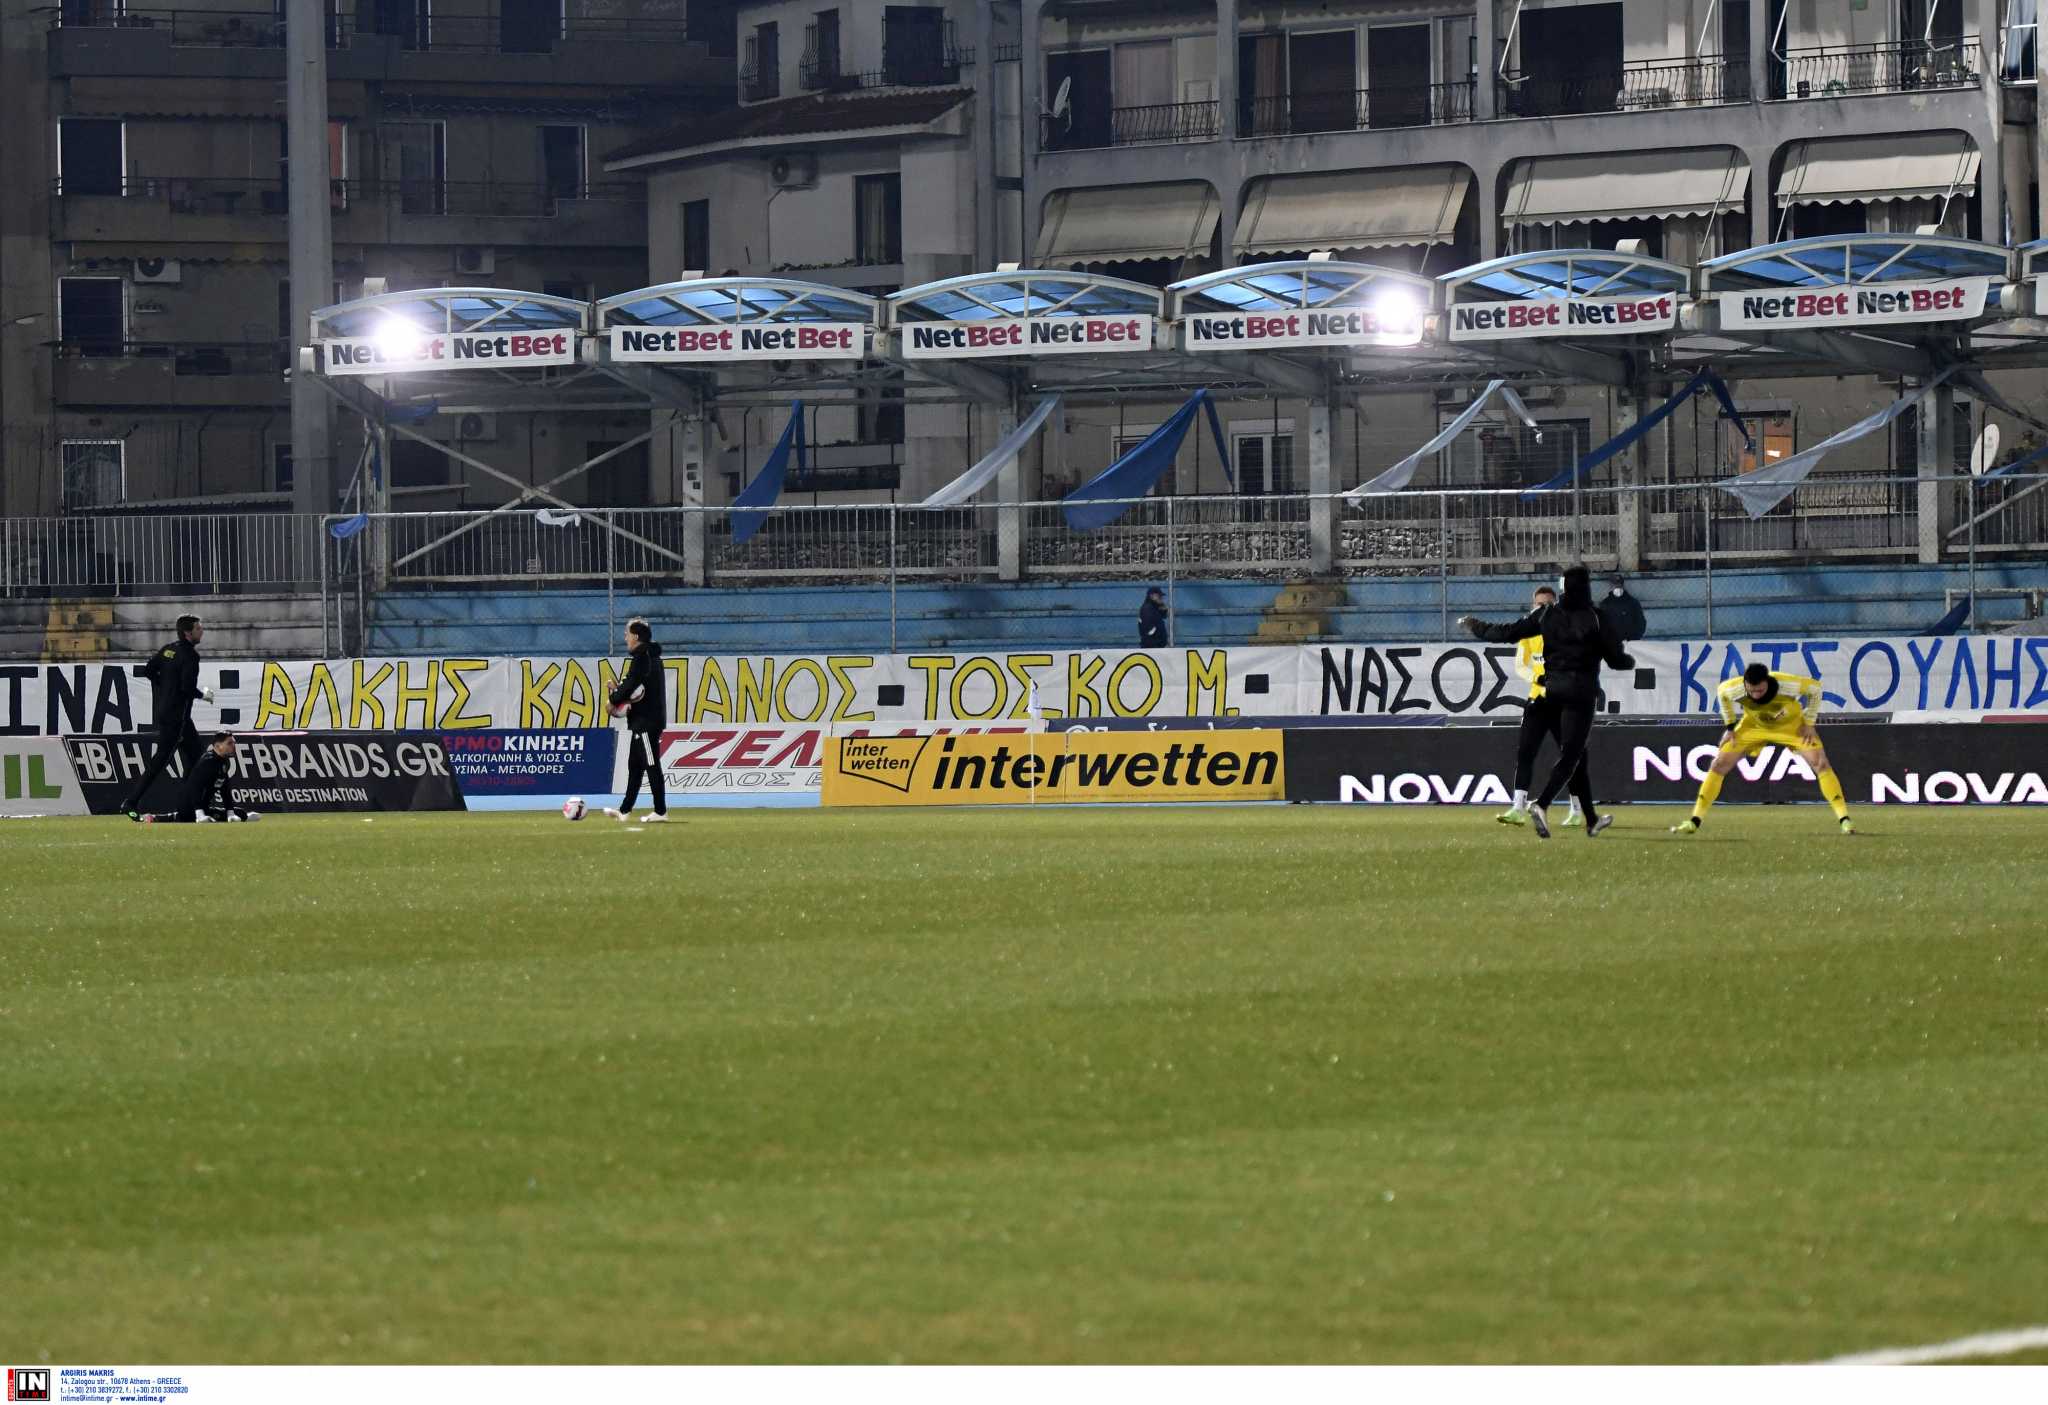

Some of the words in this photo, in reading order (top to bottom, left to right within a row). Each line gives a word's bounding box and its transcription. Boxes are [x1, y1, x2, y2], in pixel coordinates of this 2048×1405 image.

[1455, 303, 1561, 331] NetBet
[1568, 297, 1672, 325] NetBet
[1744, 292, 1849, 320] NetBet
[1857, 286, 1966, 314] NetBet
[622, 329, 734, 352] NetBet
[741, 327, 853, 350] NetBet
[913, 324, 1023, 349] NetBet
[1030, 319, 1141, 344] NetBet
[1193, 314, 1300, 341] NetBet
[453, 333, 567, 359] NetBet
[253, 658, 492, 730] ΑΛΚΗΣ
[1320, 646, 1527, 716] ΝΑΣΟΣ
[525, 753, 534, 763] &
[846, 739, 888, 757] inter
[498, 764, 565, 775] ΜΕΤΑΦΟΡΕΣ
[851, 757, 910, 770] wetten
[933, 736, 1279, 790] interwetten
[286, 787, 369, 803] DESTINATION
[1340, 773, 1515, 803] NOVA
[1872, 771, 2048, 803] NOVA
